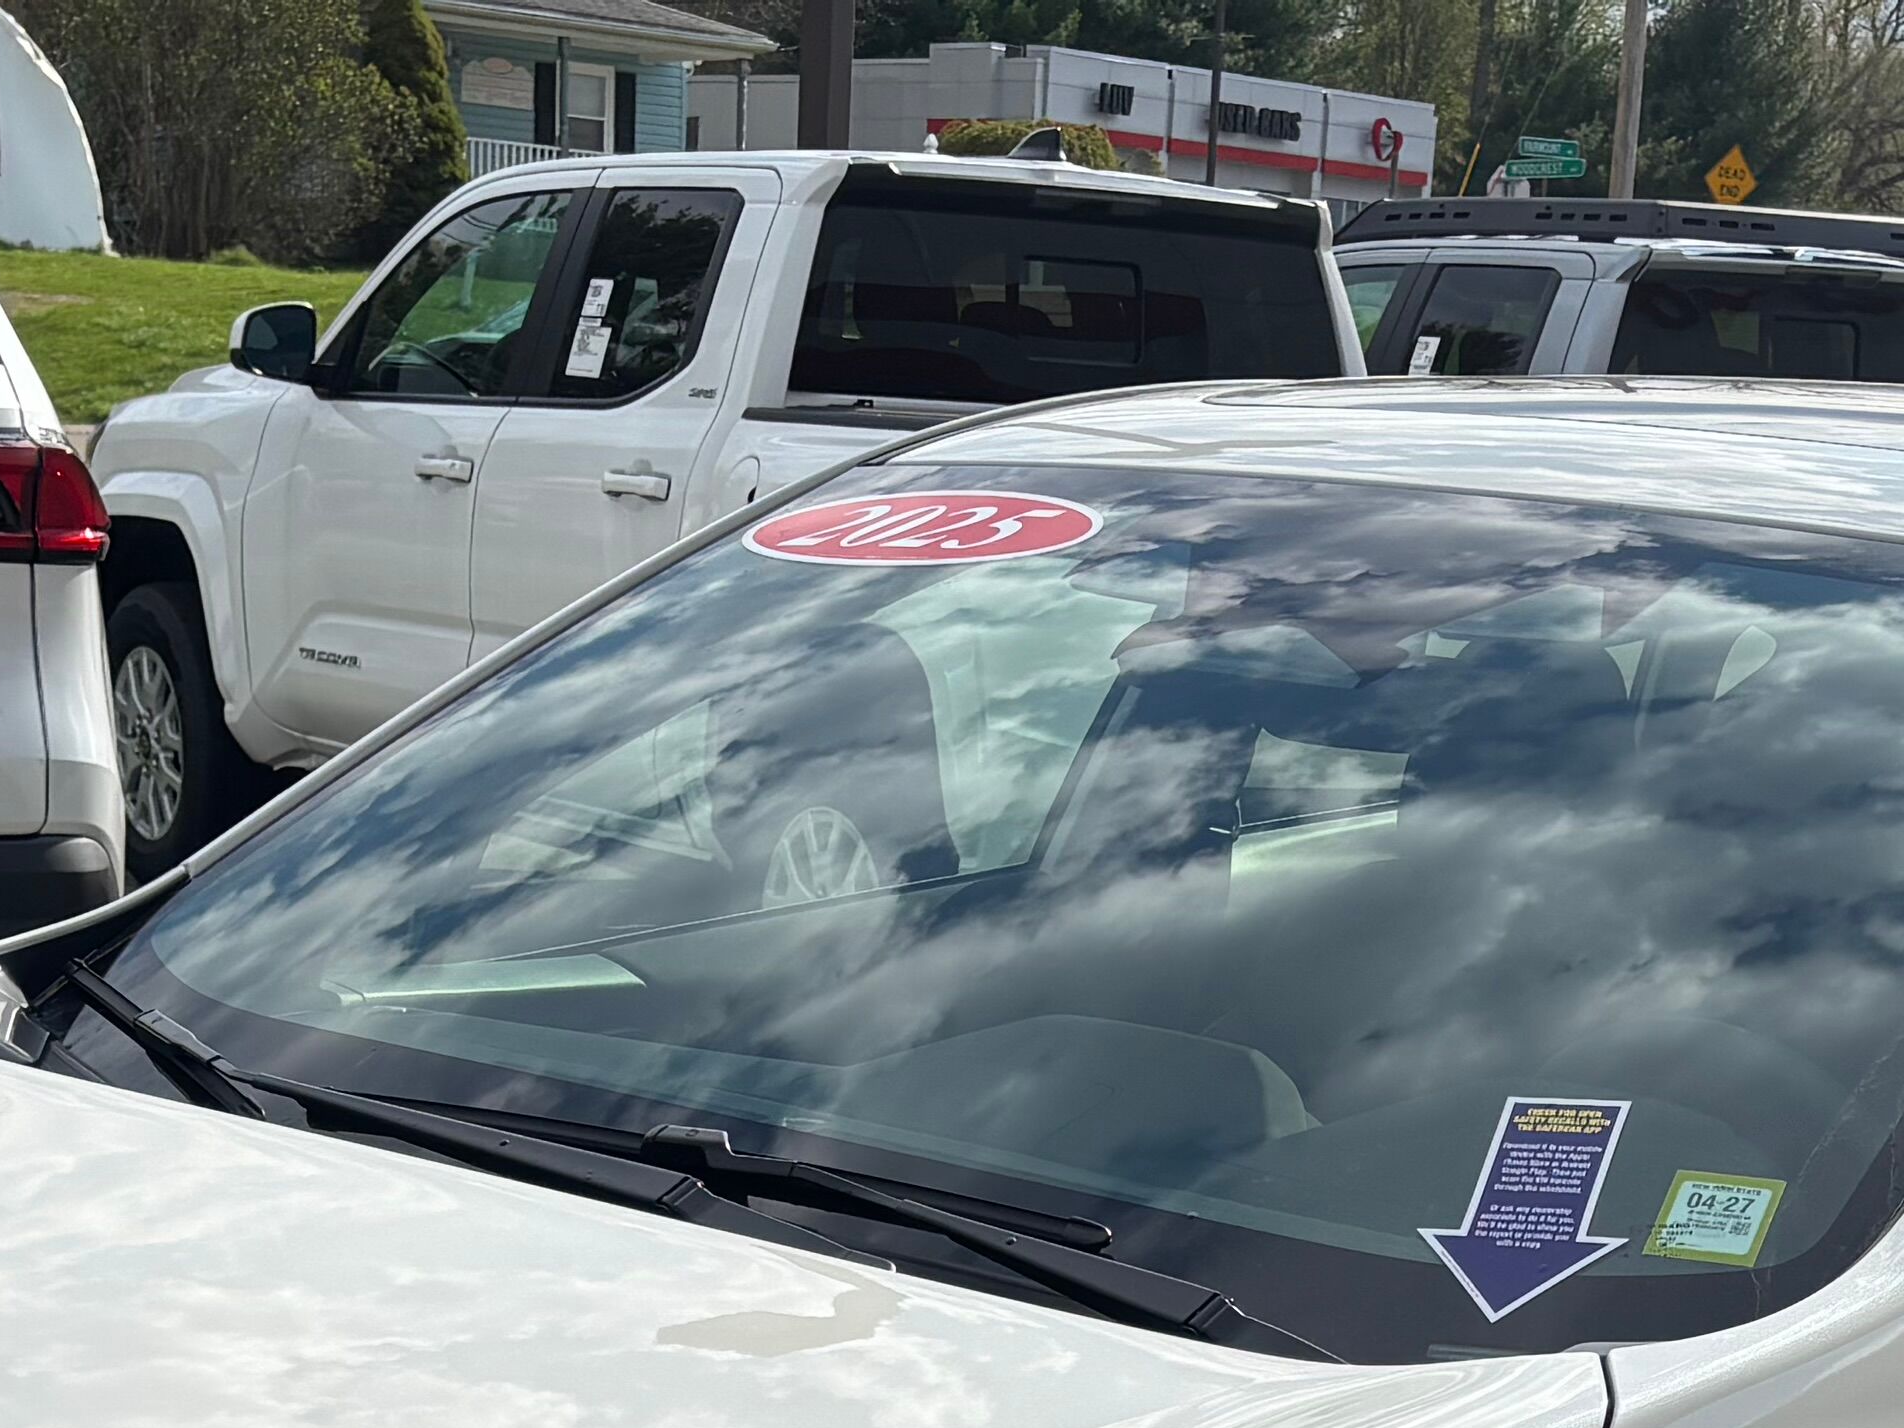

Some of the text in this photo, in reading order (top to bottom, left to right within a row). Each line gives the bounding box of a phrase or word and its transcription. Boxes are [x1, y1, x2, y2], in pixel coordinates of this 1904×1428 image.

[1099, 82, 1135, 116] LUV
[1258, 108, 1302, 141] CARS
[1511, 161, 1563, 175] WOODCREST
[1718, 166, 1746, 181] DEAD
[1720, 184, 1740, 198] END
[775, 504, 1068, 550] 2025
